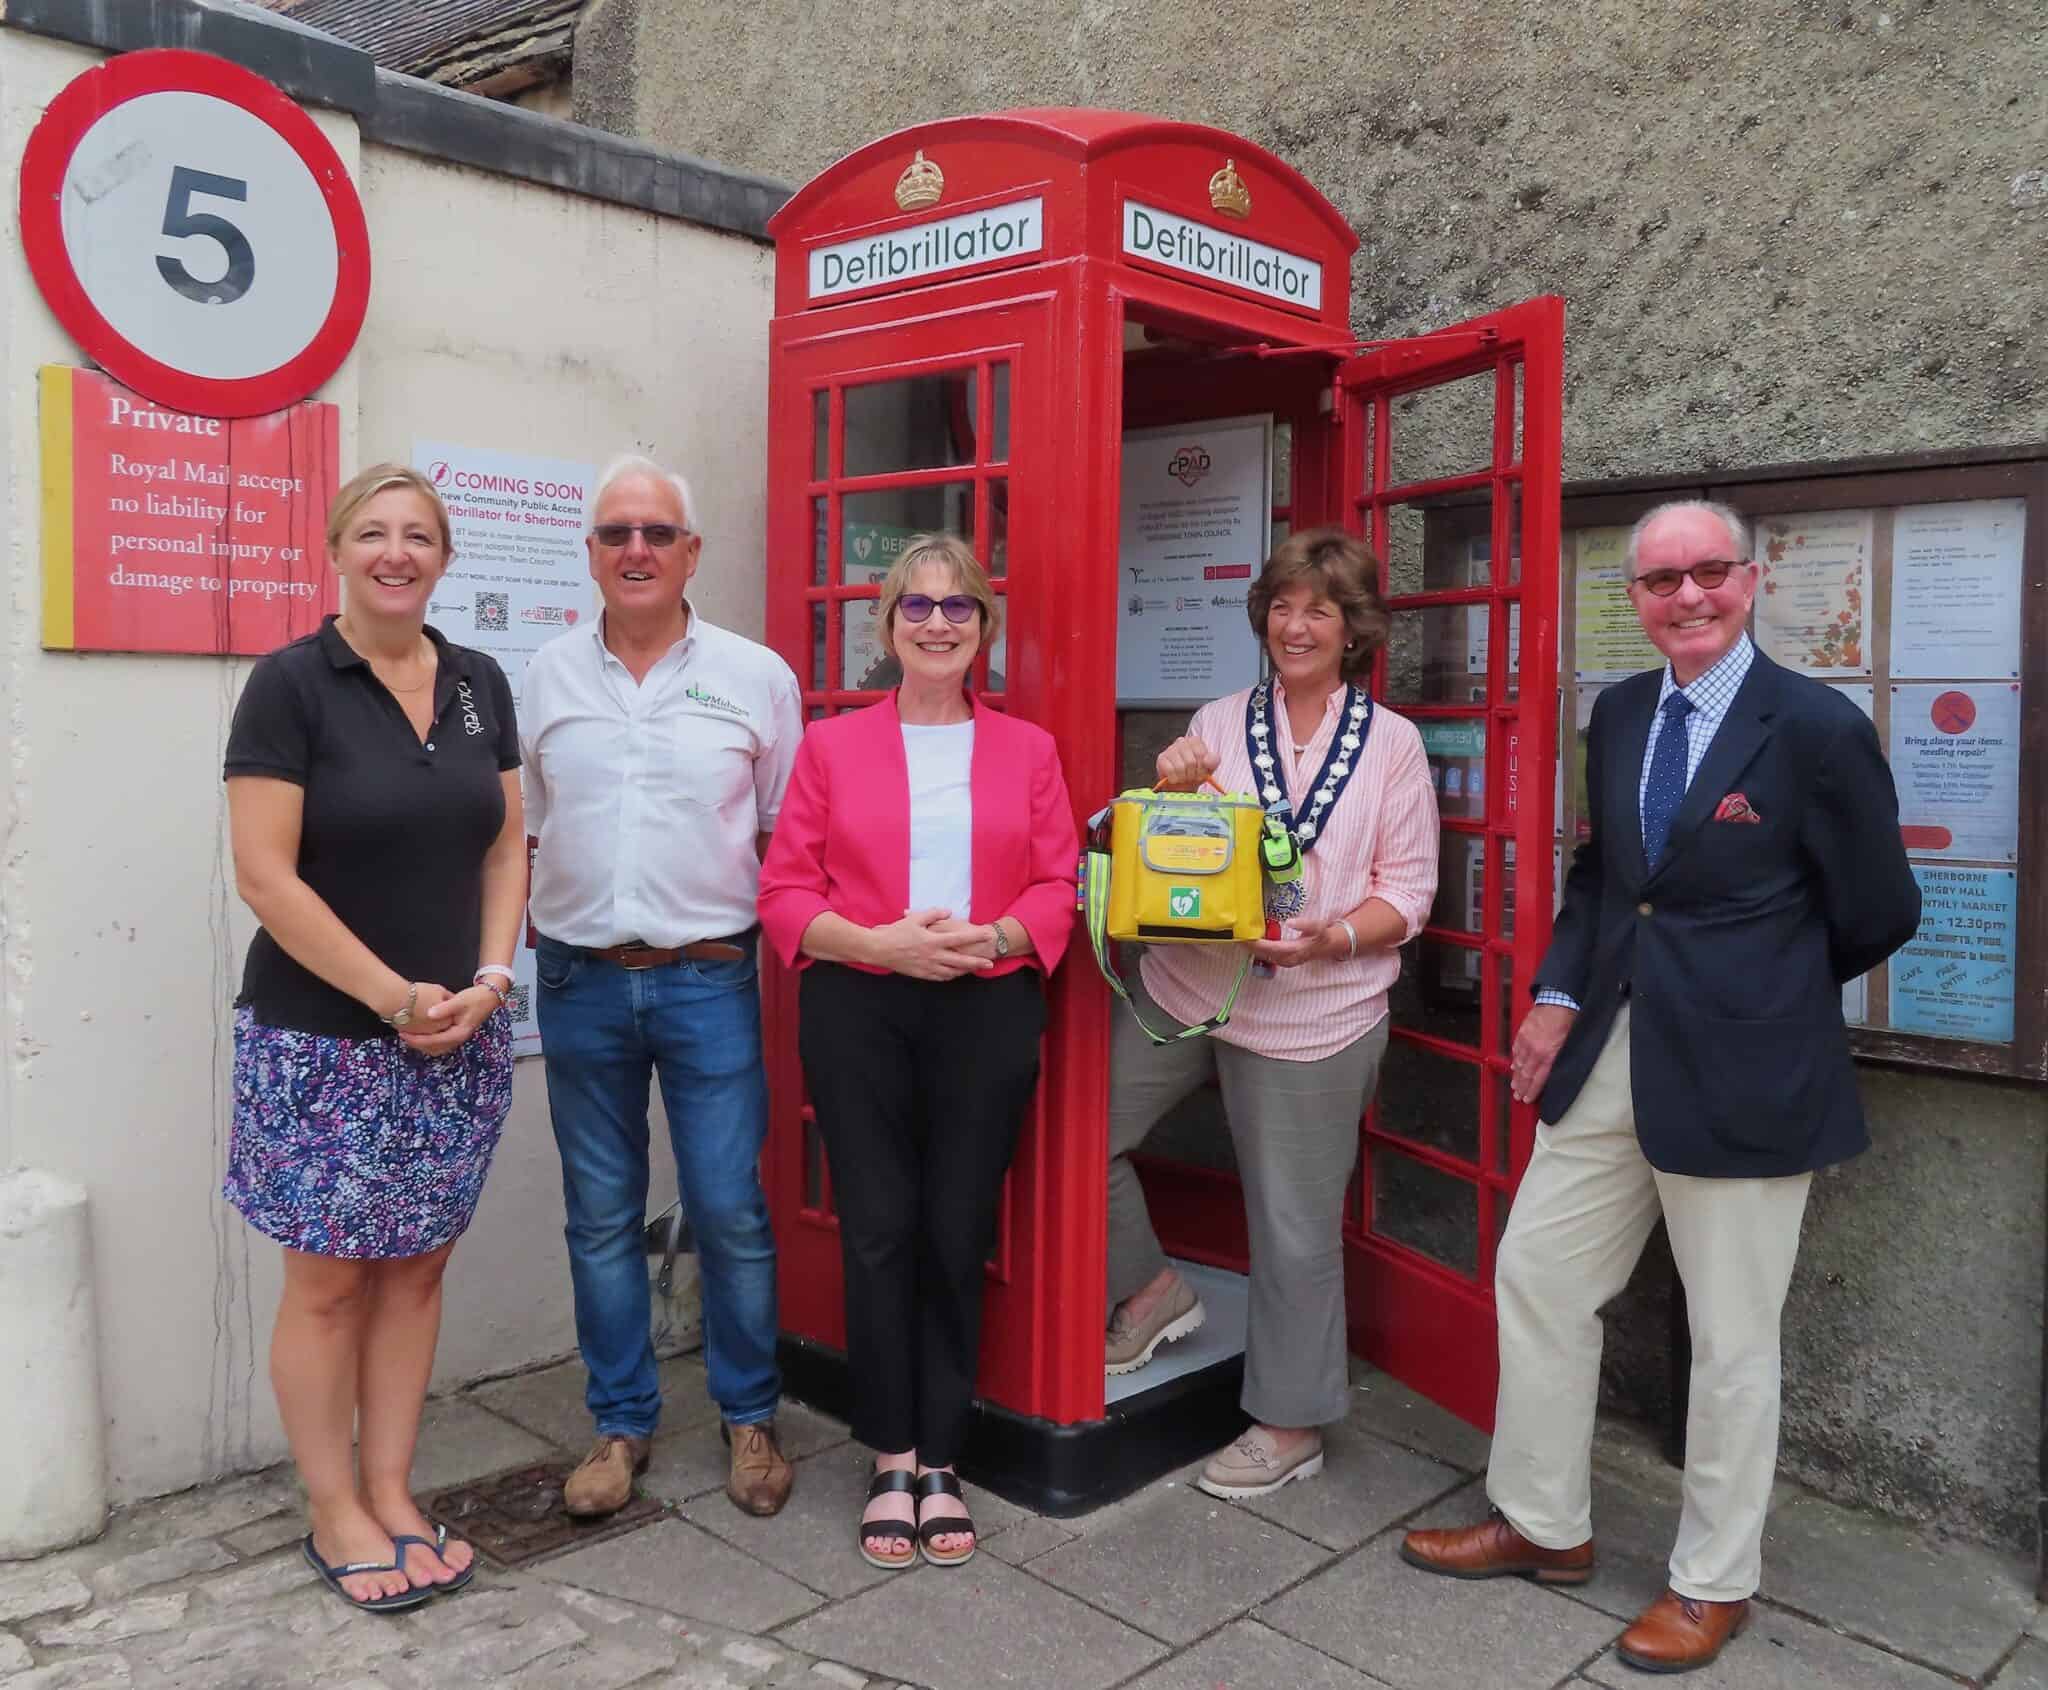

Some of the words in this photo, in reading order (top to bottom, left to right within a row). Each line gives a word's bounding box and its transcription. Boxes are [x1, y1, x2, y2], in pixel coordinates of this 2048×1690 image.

[155, 165, 256, 305] 5
[823, 214, 1031, 289] Defibrillator
[1132, 210, 1310, 298] Defibrillator
[109, 397, 222, 437] Private
[110, 453, 177, 484] Royal
[184, 460, 231, 486] Mail
[238, 471, 304, 497] accept
[455, 472, 529, 495] COMING
[534, 481, 583, 501] SOON
[110, 497, 139, 514] no
[146, 493, 228, 525] liability
[234, 500, 267, 524] for
[440, 492, 461, 501] new
[463, 493, 519, 509] Community
[521, 500, 549, 511] Public
[551, 503, 582, 515] Access
[448, 505, 501, 521] fibrillator
[505, 511, 521, 523] for
[524, 512, 583, 529] Sherborne
[110, 533, 205, 554] personal
[210, 535, 273, 565] injury
[280, 547, 304, 561] or
[110, 564, 193, 595] damage
[200, 575, 222, 591] to
[229, 578, 318, 601] property
[1904, 735, 1927, 746] Bring
[1929, 736, 1954, 746] along
[1920, 747, 1955, 757] needing
[1508, 735, 1519, 812] PUSH
[1923, 871, 1988, 883] SHERBORNE
[1923, 885, 1956, 895] DIGBY
[1959, 887, 1986, 897] HALL
[1961, 902, 2009, 913] MARKET
[1947, 917, 2007, 932] 12.30pm
